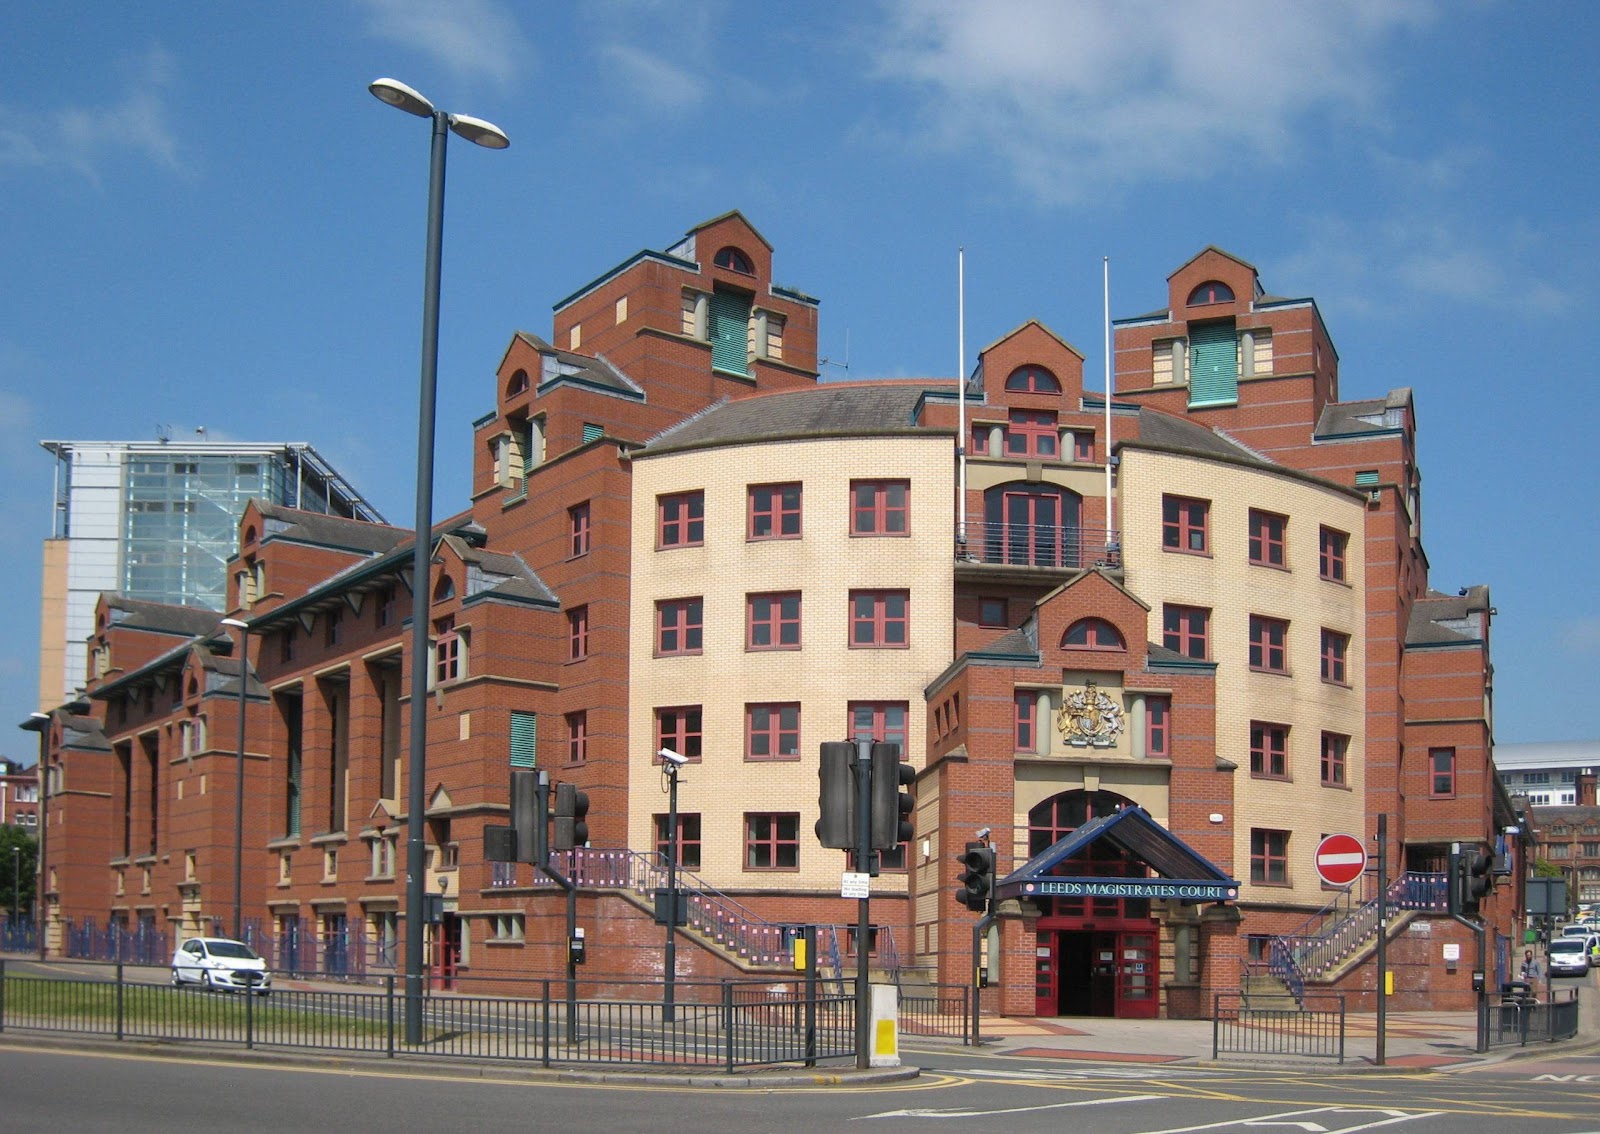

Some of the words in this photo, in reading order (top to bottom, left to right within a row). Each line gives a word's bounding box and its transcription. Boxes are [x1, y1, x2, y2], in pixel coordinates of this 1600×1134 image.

[1040, 882, 1082, 895] LEEDS
[1085, 884, 1176, 897] MAGISTRATES
[1179, 885, 1223, 898] COURT
